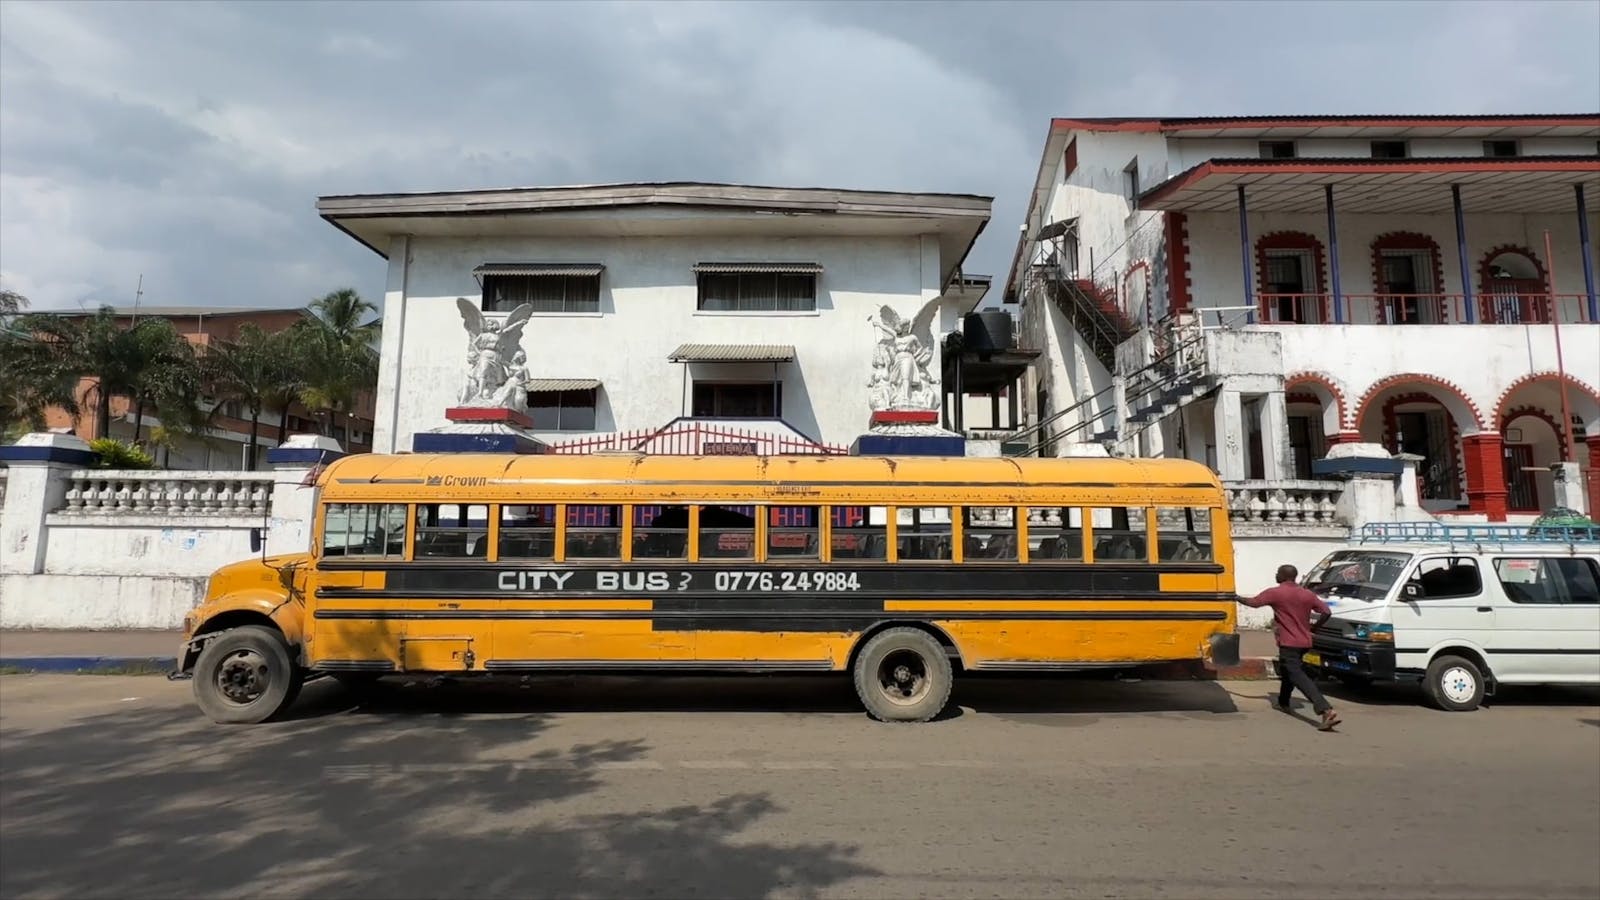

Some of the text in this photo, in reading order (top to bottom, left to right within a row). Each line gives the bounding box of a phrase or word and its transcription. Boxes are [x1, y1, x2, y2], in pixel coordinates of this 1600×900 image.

[444, 475, 487, 487] Crown
[498, 571, 575, 591] CITY
[596, 571, 670, 591] BUS
